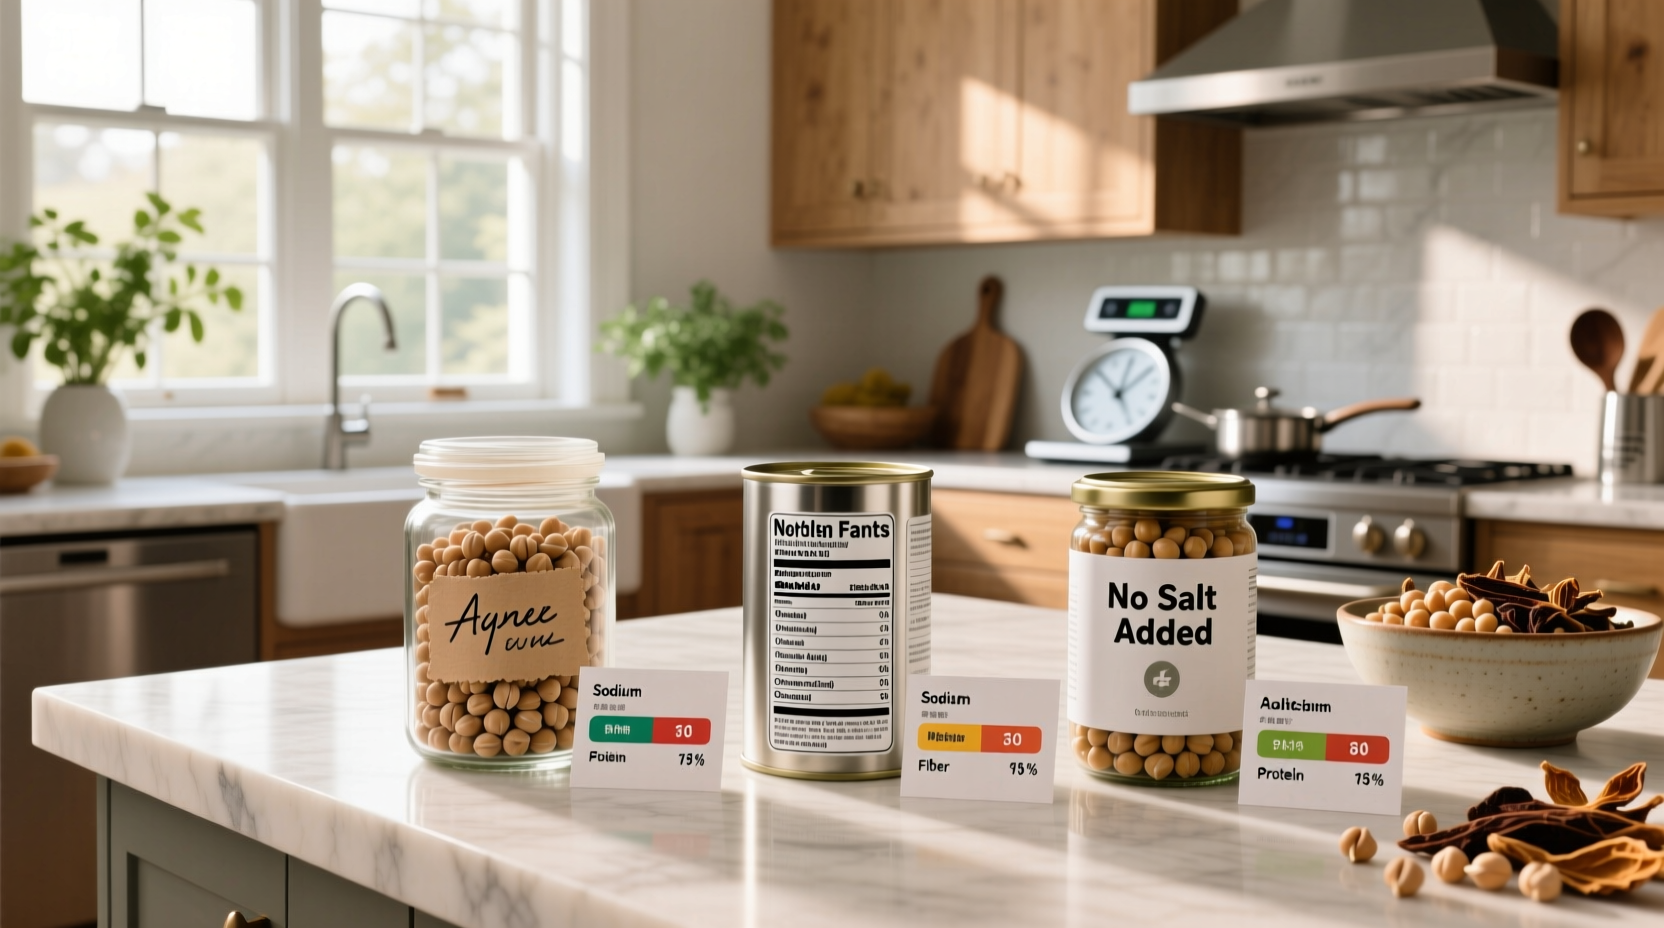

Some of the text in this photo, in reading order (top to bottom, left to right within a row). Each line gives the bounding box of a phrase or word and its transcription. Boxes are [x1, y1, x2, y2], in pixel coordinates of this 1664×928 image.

[839, 521, 890, 538] Fants
[1108, 582, 1217, 611] No Salt
[1114, 617, 1212, 646] Added
[593, 684, 642, 698] Sodium
[1258, 767, 1304, 781] Protein
